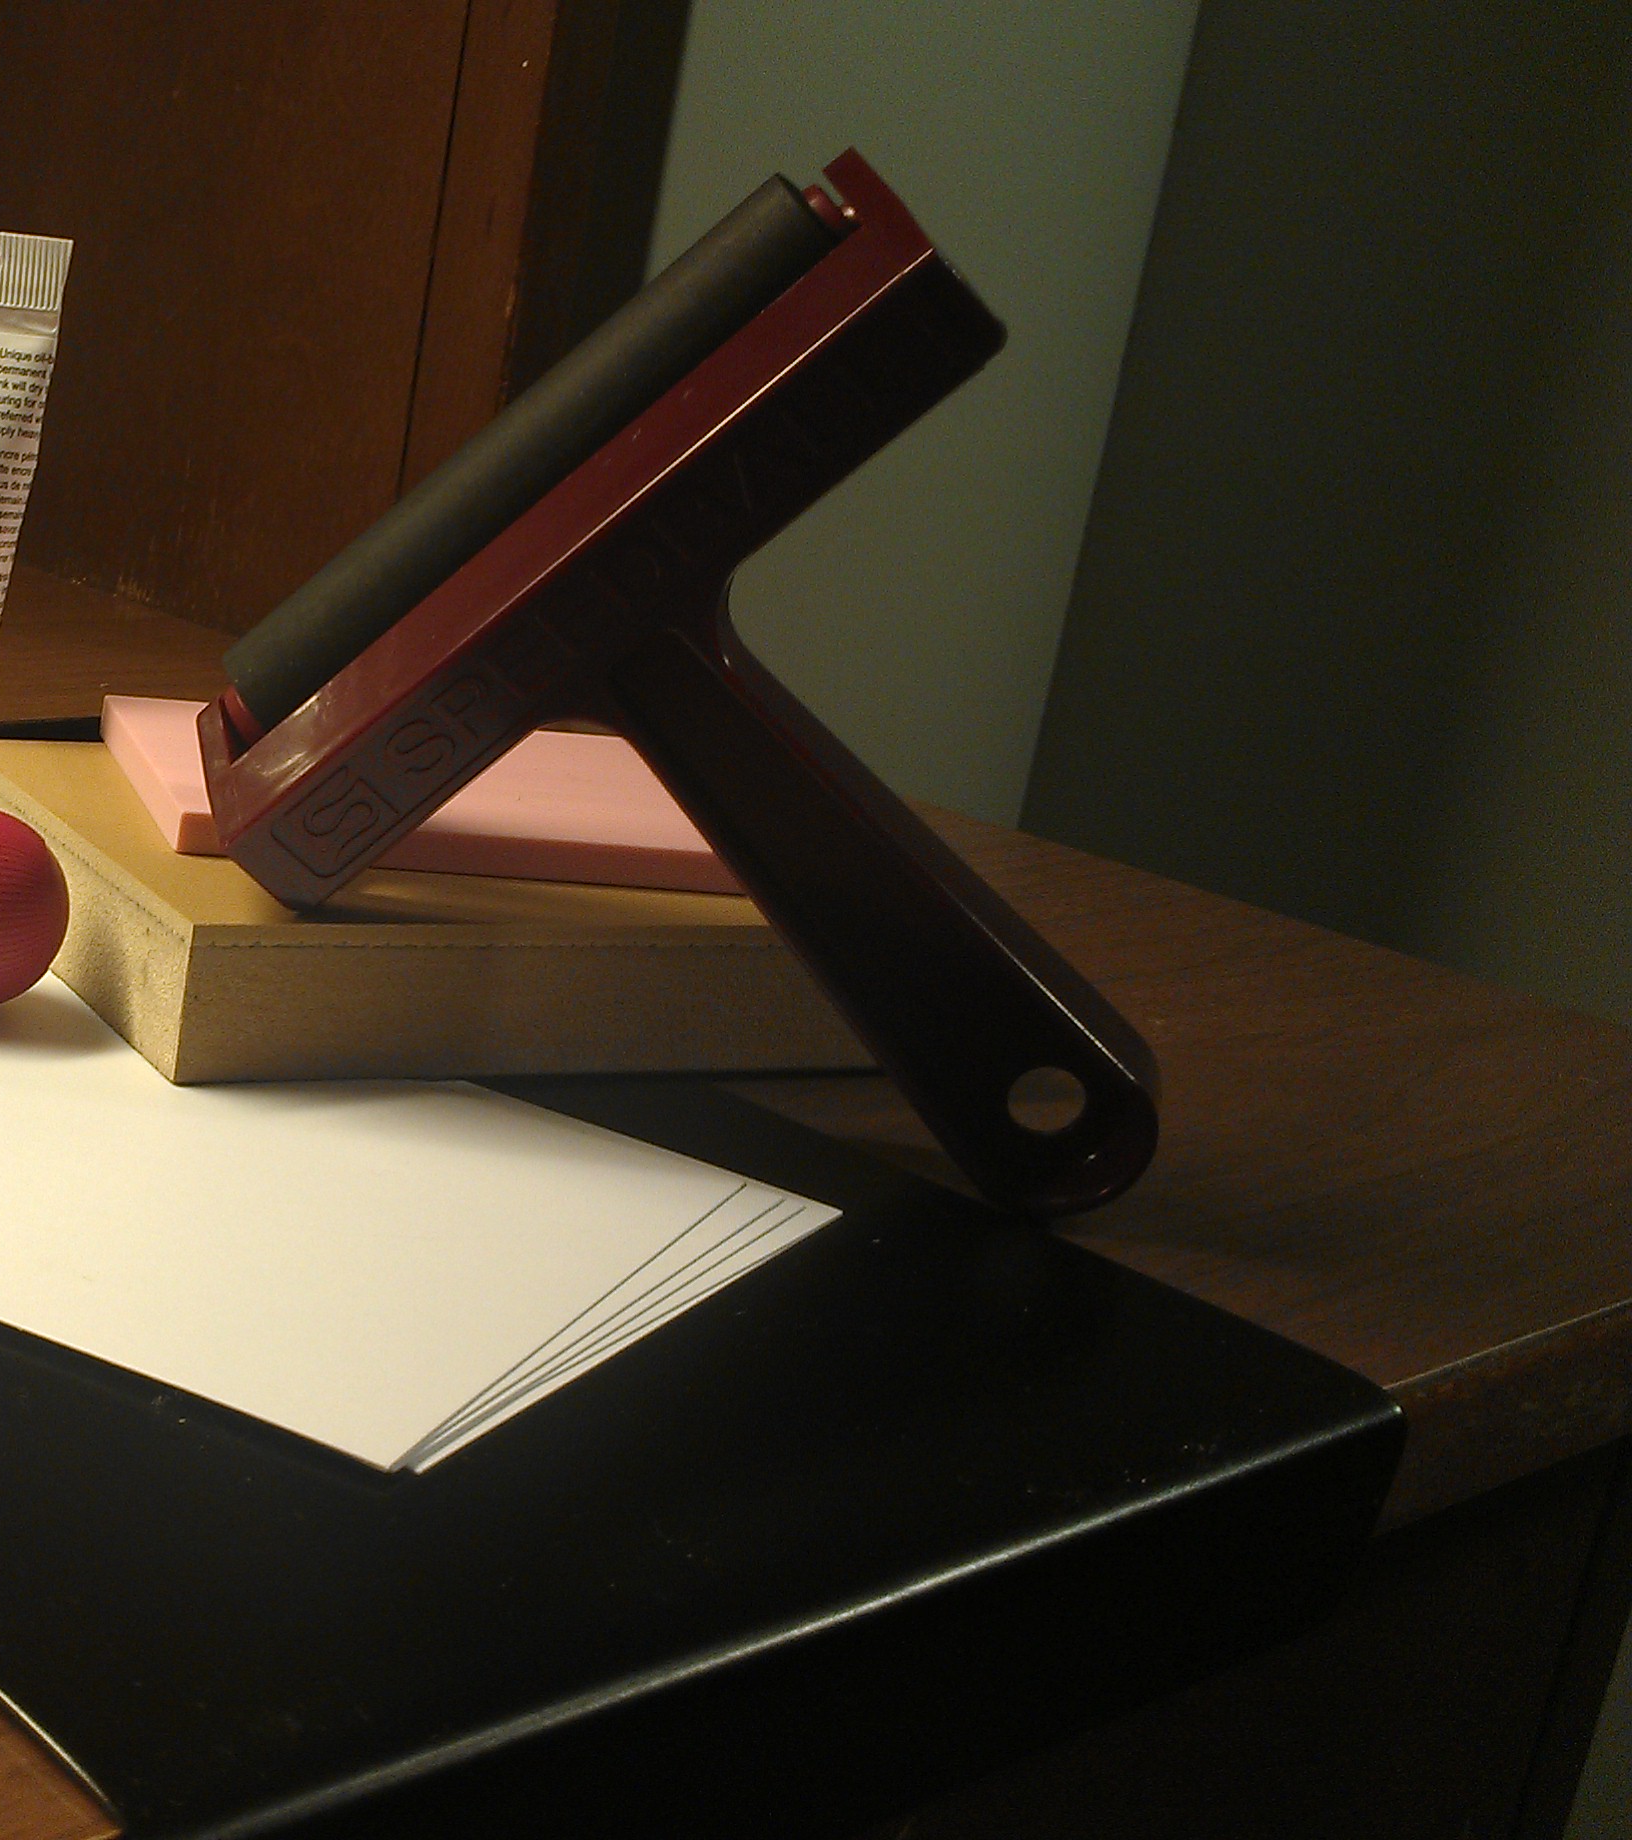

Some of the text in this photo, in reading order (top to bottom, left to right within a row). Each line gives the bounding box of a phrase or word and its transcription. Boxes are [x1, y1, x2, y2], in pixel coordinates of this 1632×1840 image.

[0, 347, 31, 362] Unique
[11, 381, 26, 391] will
[28, 382, 44, 396] dry
[23, 396, 37, 409] for
